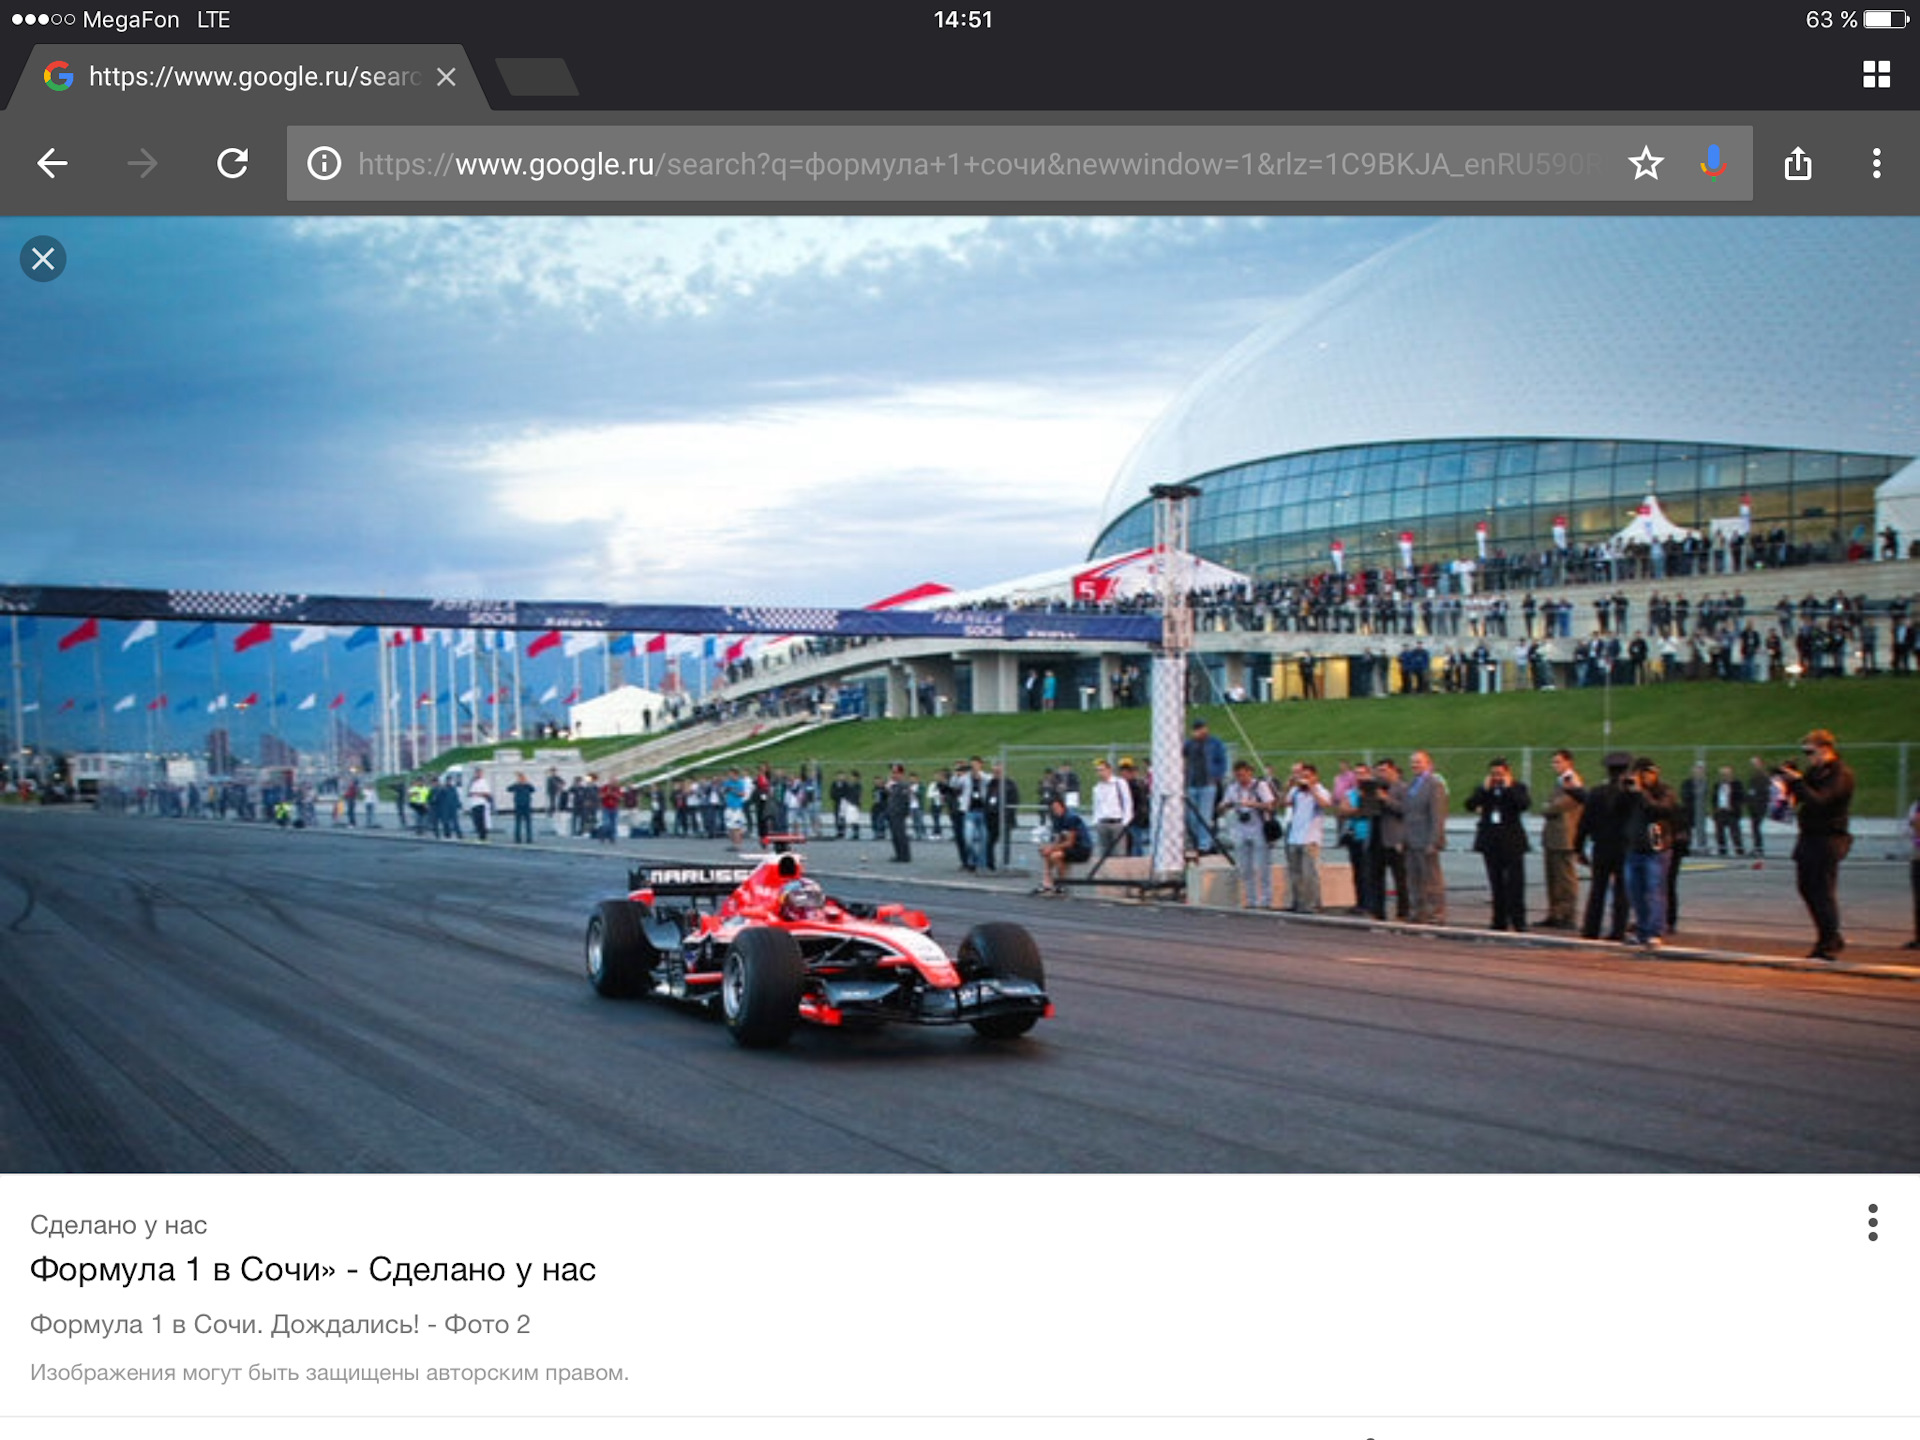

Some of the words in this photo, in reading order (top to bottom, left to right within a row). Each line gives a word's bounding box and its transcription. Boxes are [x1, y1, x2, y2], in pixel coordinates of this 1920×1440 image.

[83, 10, 180, 33] MegaFon
[197, 10, 231, 29] LTE
[934, 10, 992, 29] 14:51
[1805, 10, 1834, 29] 63
[1840, 10, 1859, 29] %
[30, 1213, 137, 1240] Сделано
[143, 1219, 158, 1240] у
[165, 1219, 208, 1235] нас
[30, 1254, 177, 1289] Формула
[186, 1255, 198, 1282] 1
[213, 1262, 231, 1282] в
[240, 1254, 336, 1283] Сочи»
[368, 1254, 506, 1287] Сделано
[515, 1262, 534, 1289] у
[543, 1262, 597, 1283] нас
[30, 1312, 144, 1340] Формула
[152, 1313, 161, 1334] 1
[172, 1318, 186, 1334] в
[193, 1313, 263, 1335] Сочи.
[270, 1313, 419, 1339] Дождались!
[444, 1312, 510, 1335] Фото
[516, 1313, 531, 1334] 2
[31, 1362, 176, 1386] Изображения
[183, 1367, 243, 1386] могут
[248, 1362, 300, 1381] быть
[305, 1367, 419, 1385] защищены
[425, 1367, 539, 1386] авторским
[545, 1367, 629, 1386] правом.
